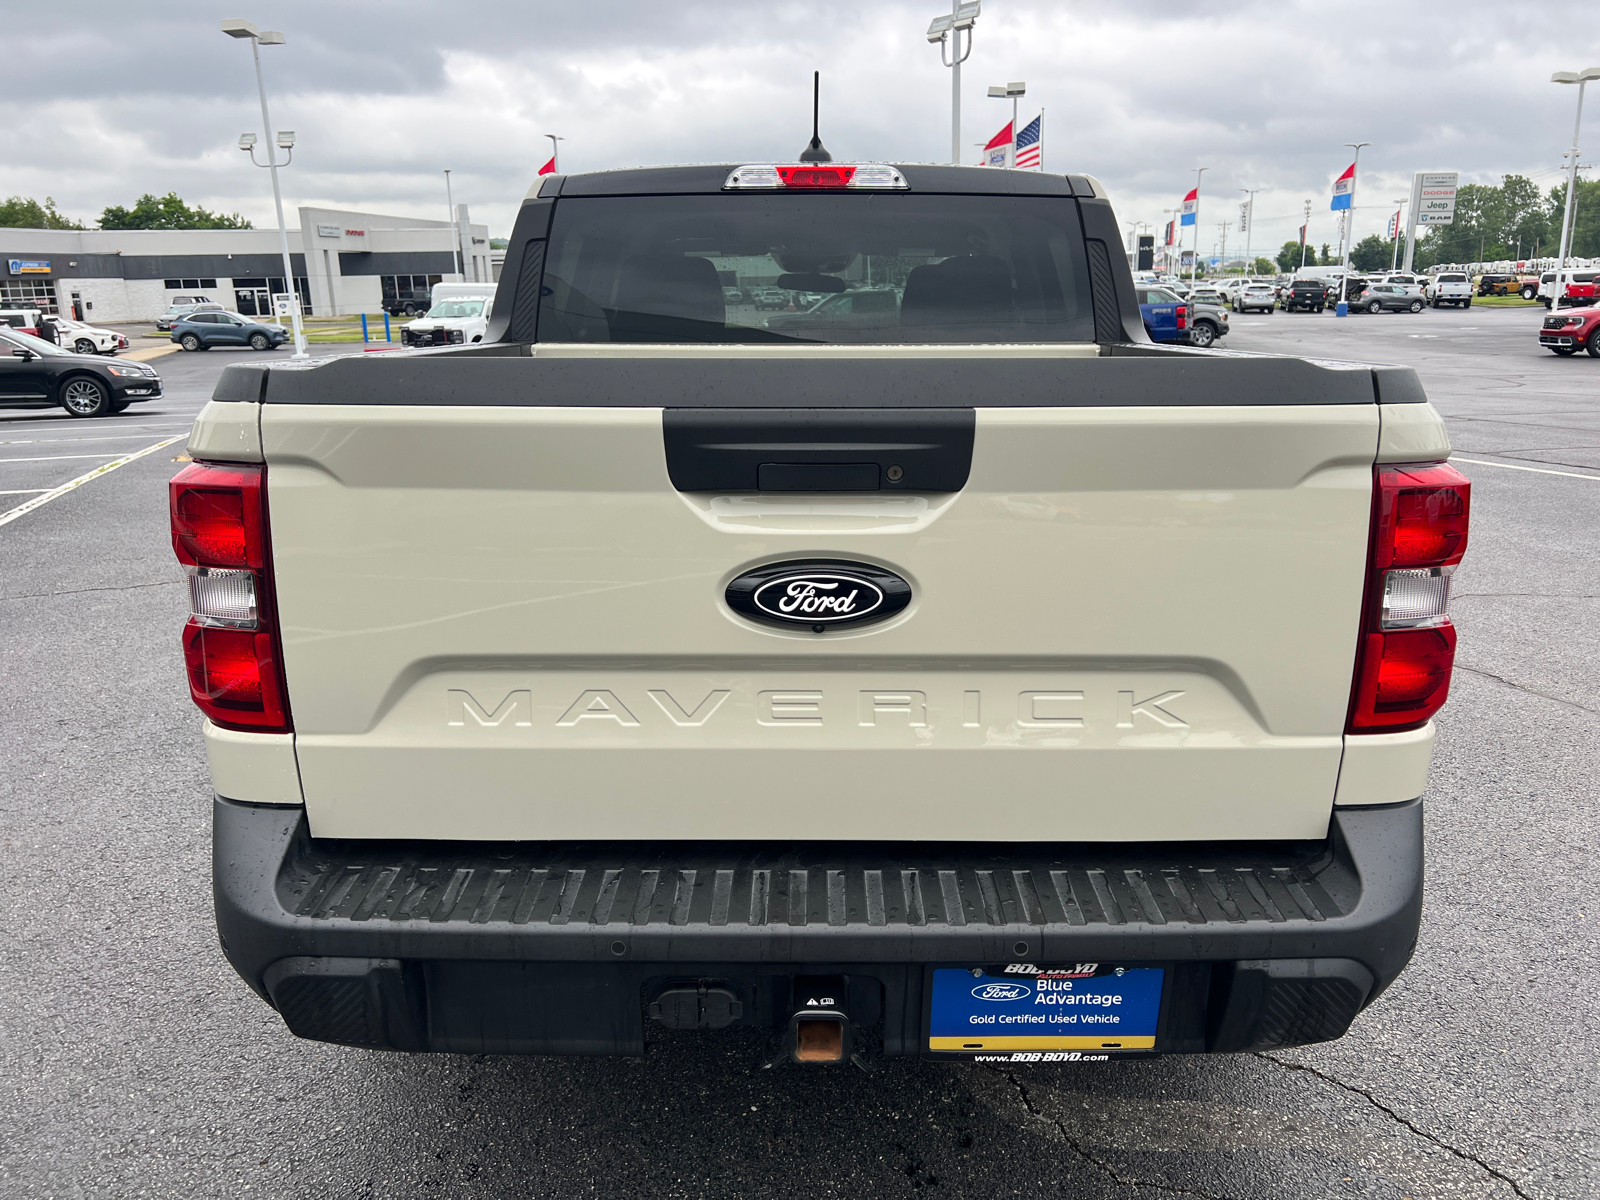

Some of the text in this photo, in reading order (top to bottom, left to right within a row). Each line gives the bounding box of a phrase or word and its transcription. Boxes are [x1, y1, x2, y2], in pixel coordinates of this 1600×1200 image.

[1427, 201, 1448, 210] Jeep
[779, 581, 858, 612] Ford
[447, 689, 1191, 729] MAVERICK
[982, 985, 1019, 998] Ford
[1036, 979, 1073, 991] Blue
[1034, 992, 1123, 1007] Advantage
[969, 1014, 1120, 1024] Gold Certified Used Vehicle
